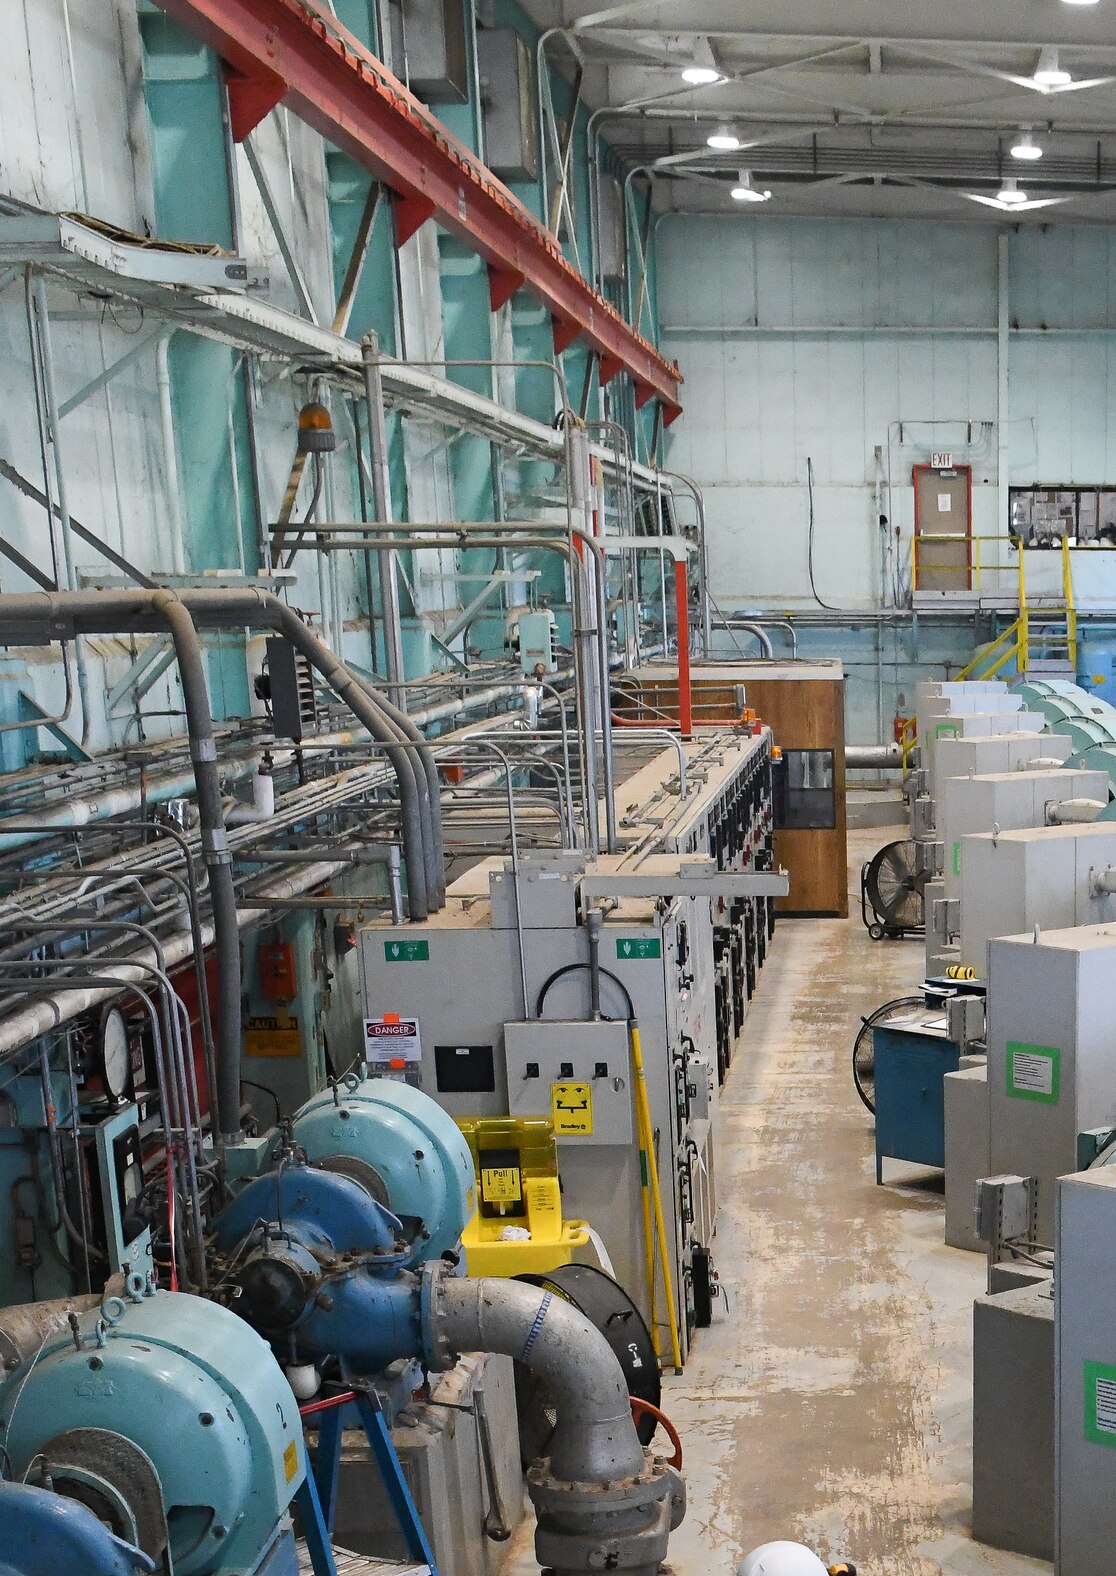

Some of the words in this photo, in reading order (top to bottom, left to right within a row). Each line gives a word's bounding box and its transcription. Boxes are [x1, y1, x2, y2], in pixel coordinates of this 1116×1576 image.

[932, 453, 951, 466] EXIT
[374, 1026, 409, 1034] DANGER
[494, 1170, 508, 1178] Pull
